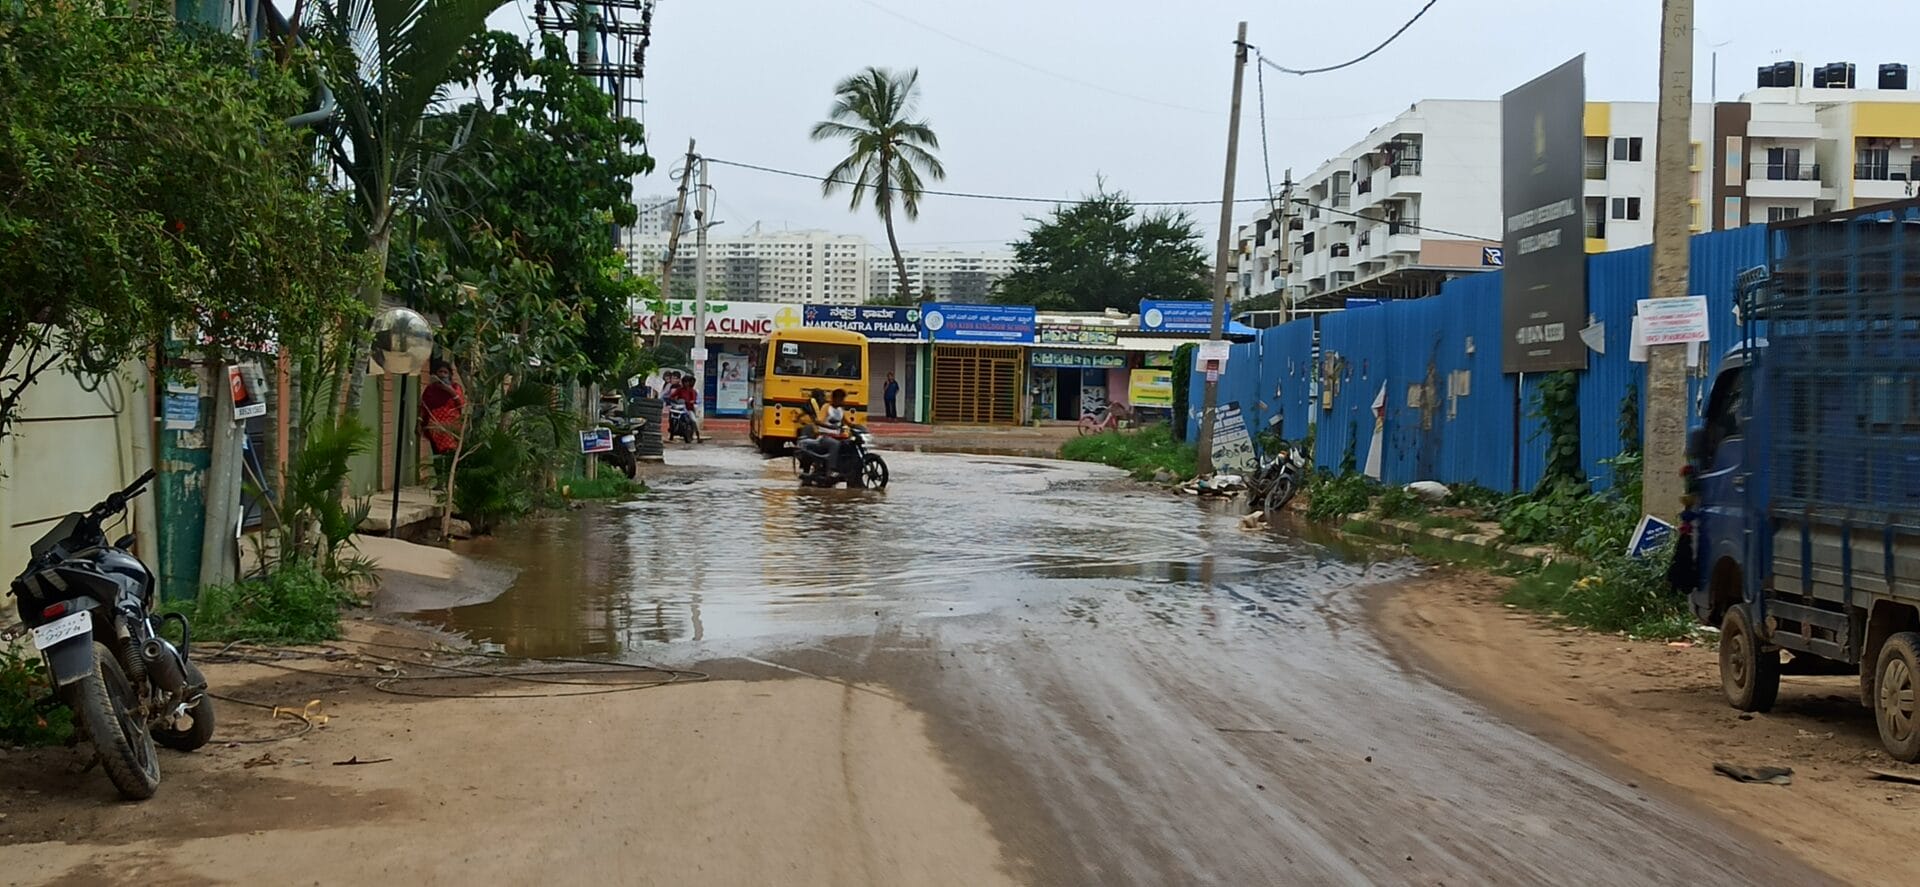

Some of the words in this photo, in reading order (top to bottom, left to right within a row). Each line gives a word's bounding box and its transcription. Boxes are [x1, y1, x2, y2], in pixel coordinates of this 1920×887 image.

[720, 318, 772, 334] CLINIC
[805, 320, 872, 331] NAKKSHATRA
[874, 322, 917, 332] PHARMA
